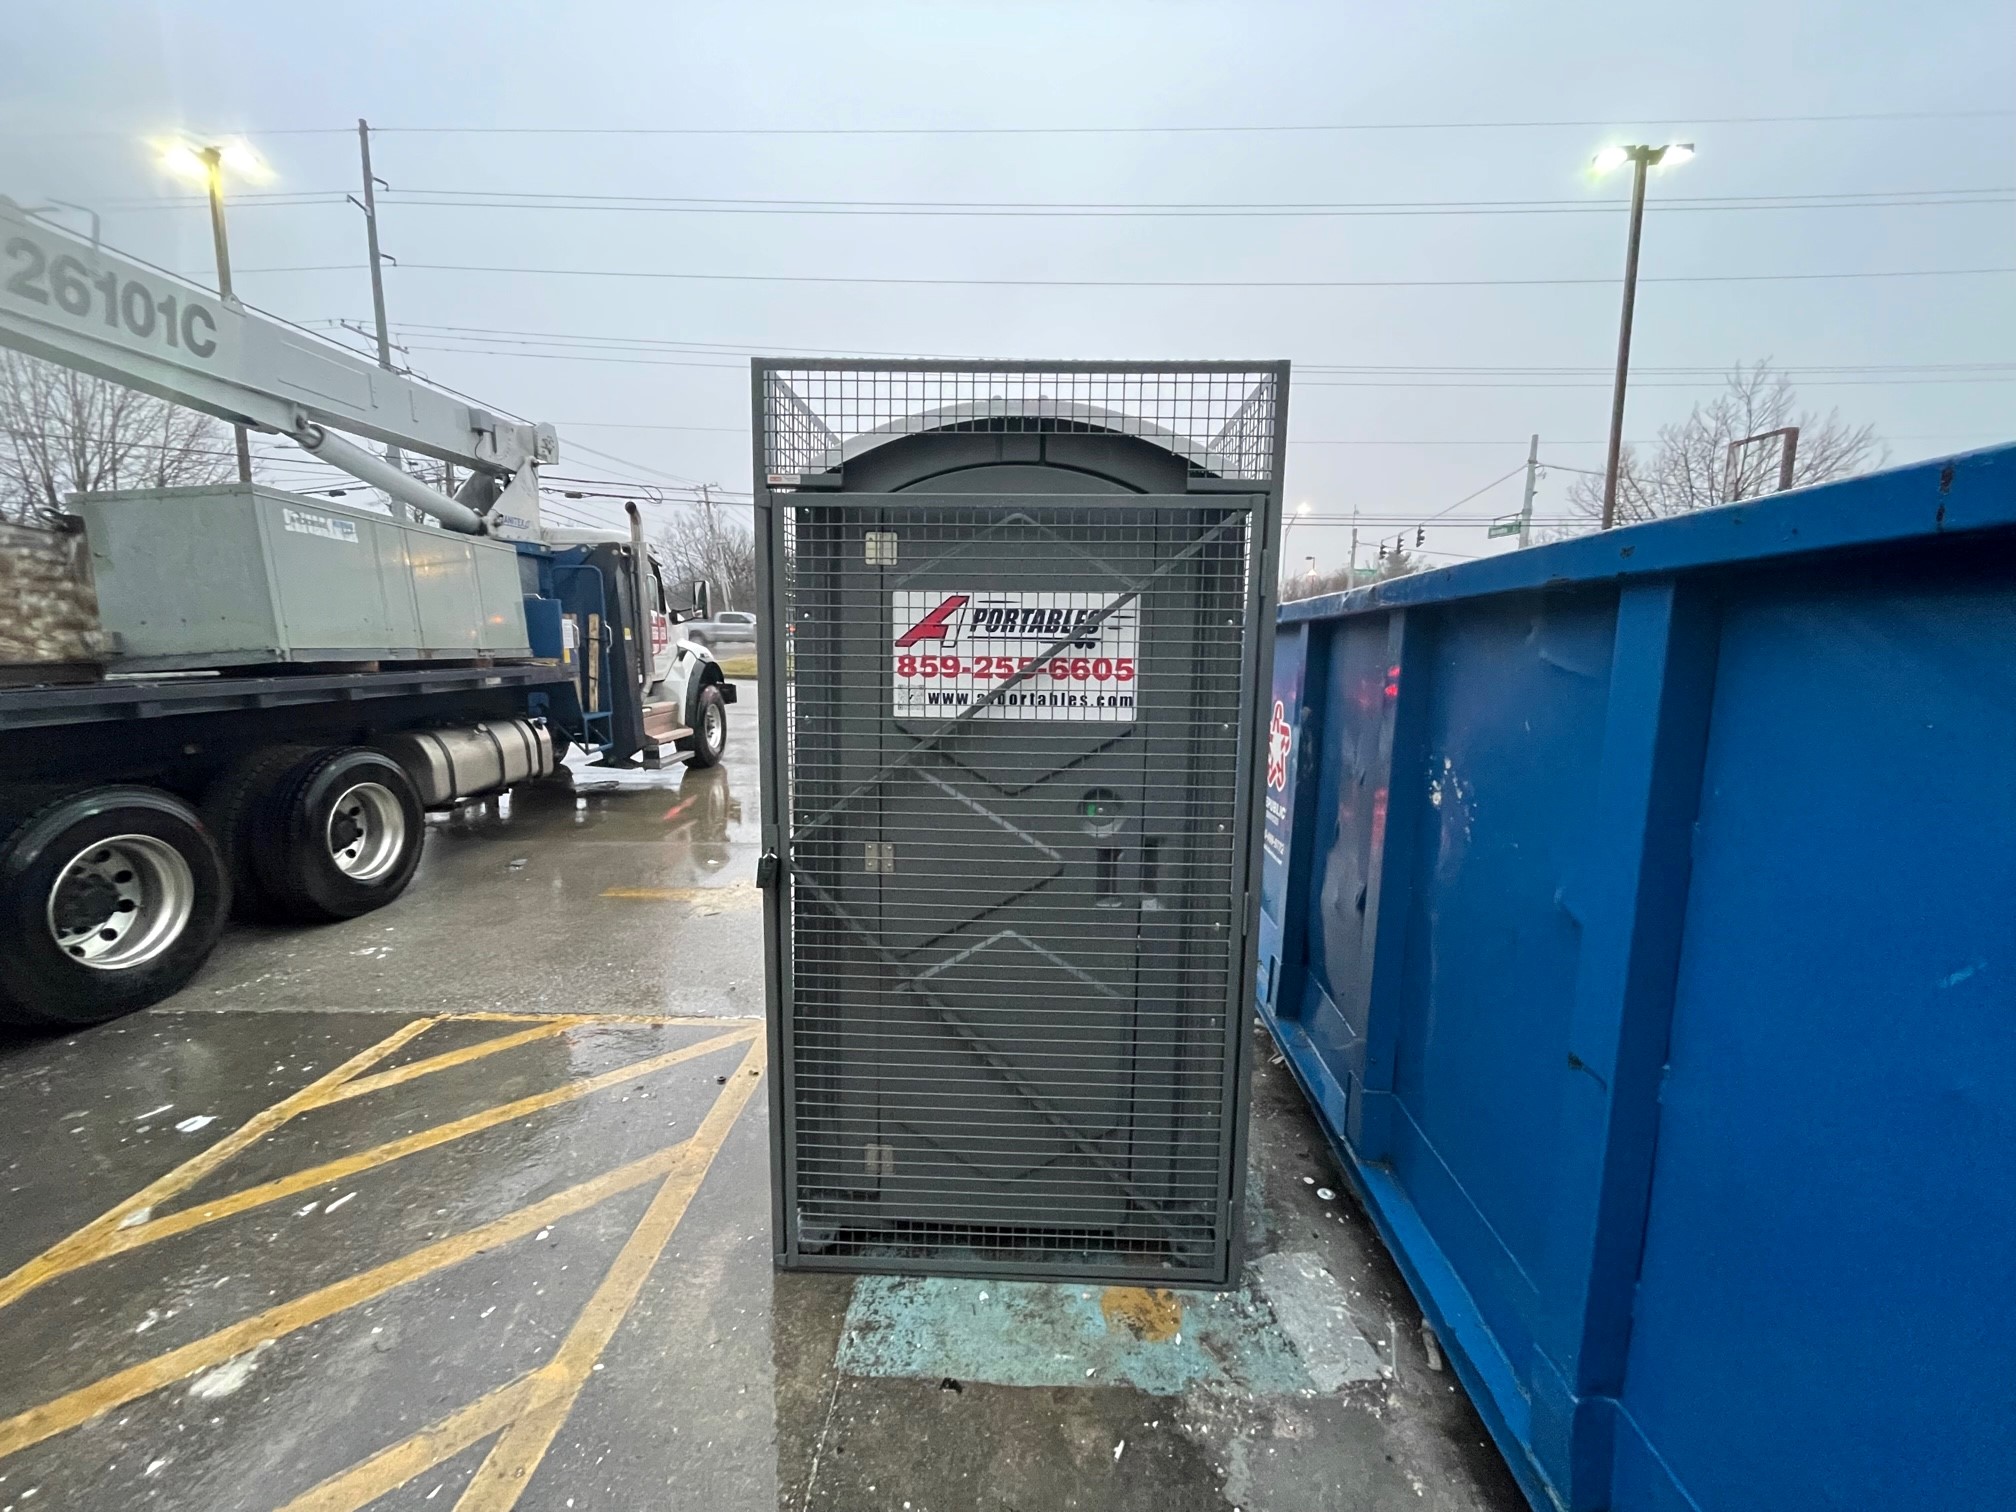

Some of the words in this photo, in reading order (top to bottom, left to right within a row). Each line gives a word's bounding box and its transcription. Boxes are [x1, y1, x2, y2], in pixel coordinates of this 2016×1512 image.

[6, 237, 217, 358] 26101C
[970, 608, 1099, 634] PORTABLES
[897, 654, 1134, 681] 859-255-6605
[928, 692, 1133, 707] www.aportables.com
